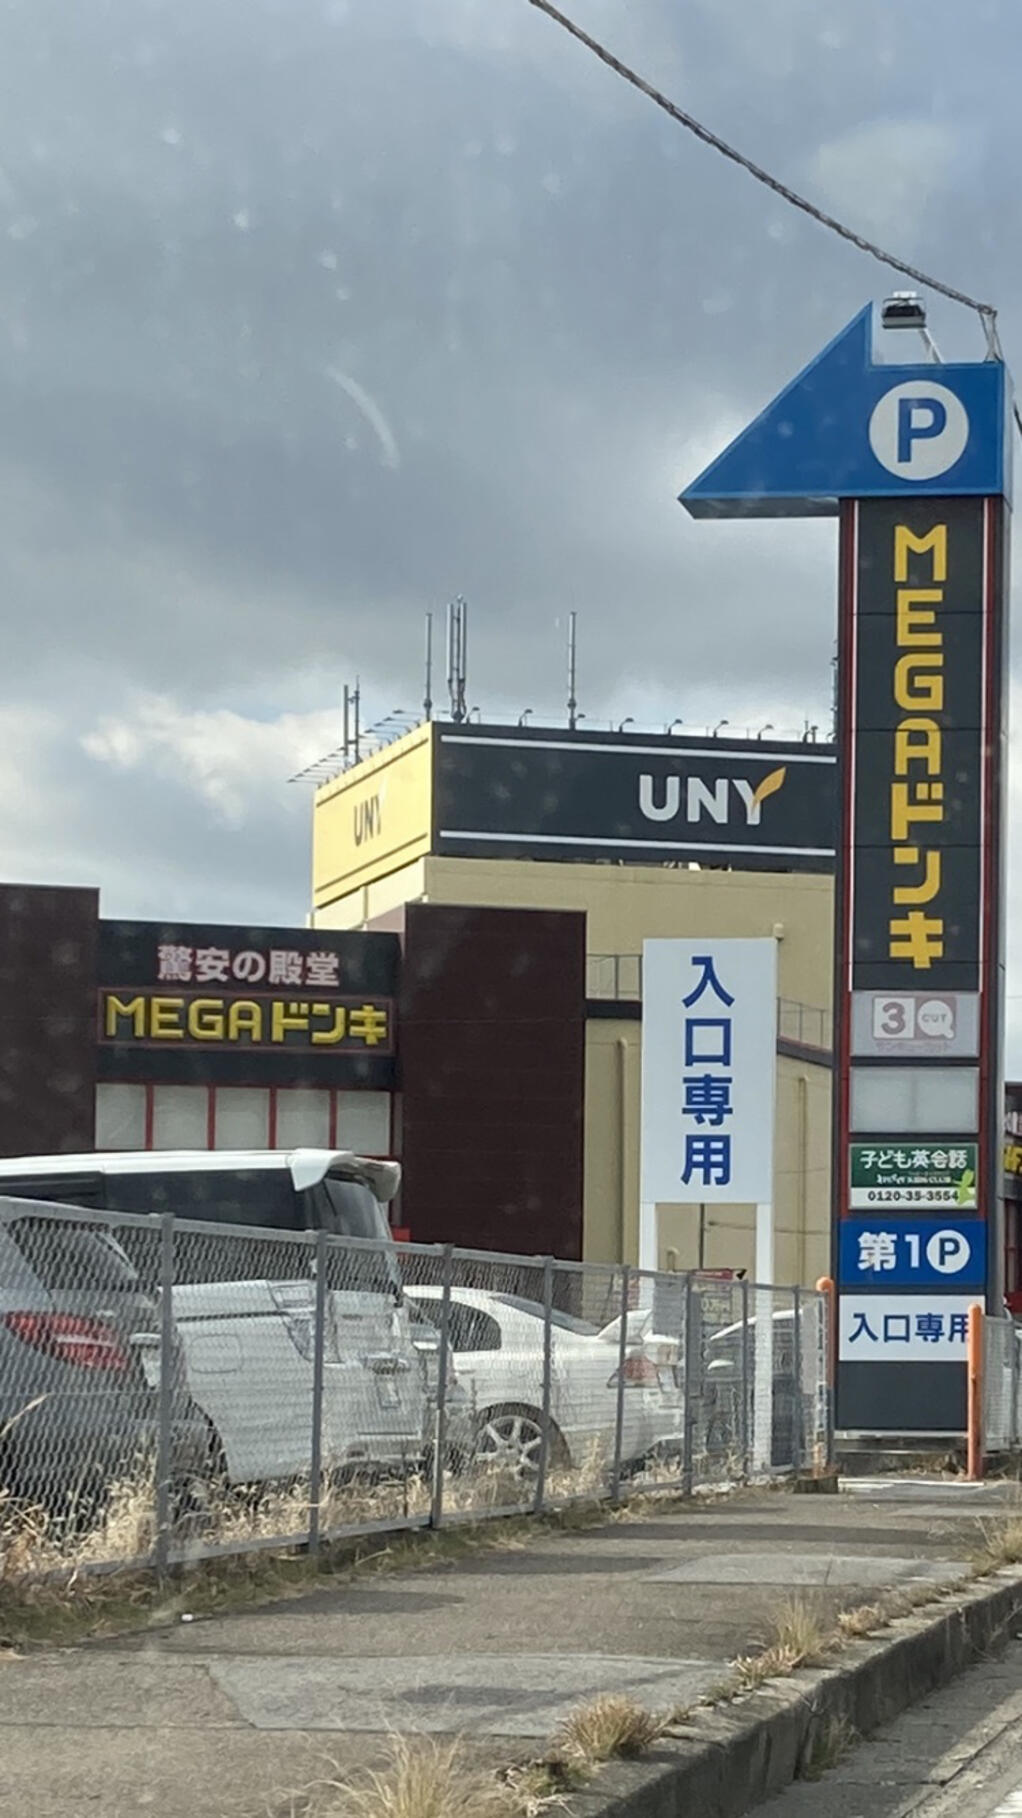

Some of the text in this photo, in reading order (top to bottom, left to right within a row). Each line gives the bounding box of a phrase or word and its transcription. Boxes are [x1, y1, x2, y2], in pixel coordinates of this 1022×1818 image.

[898, 398, 946, 463] P
[891, 524, 948, 969] MEGAドンキ
[354, 792, 384, 846] UNY
[639, 766, 786, 825] UNY
[157, 945, 340, 986] 驚安の殿堂
[106, 995, 386, 1046] MEGAドンキ
[681, 956, 735, 1187] 入口専用
[860, 1149, 968, 1169] 子ども英会話
